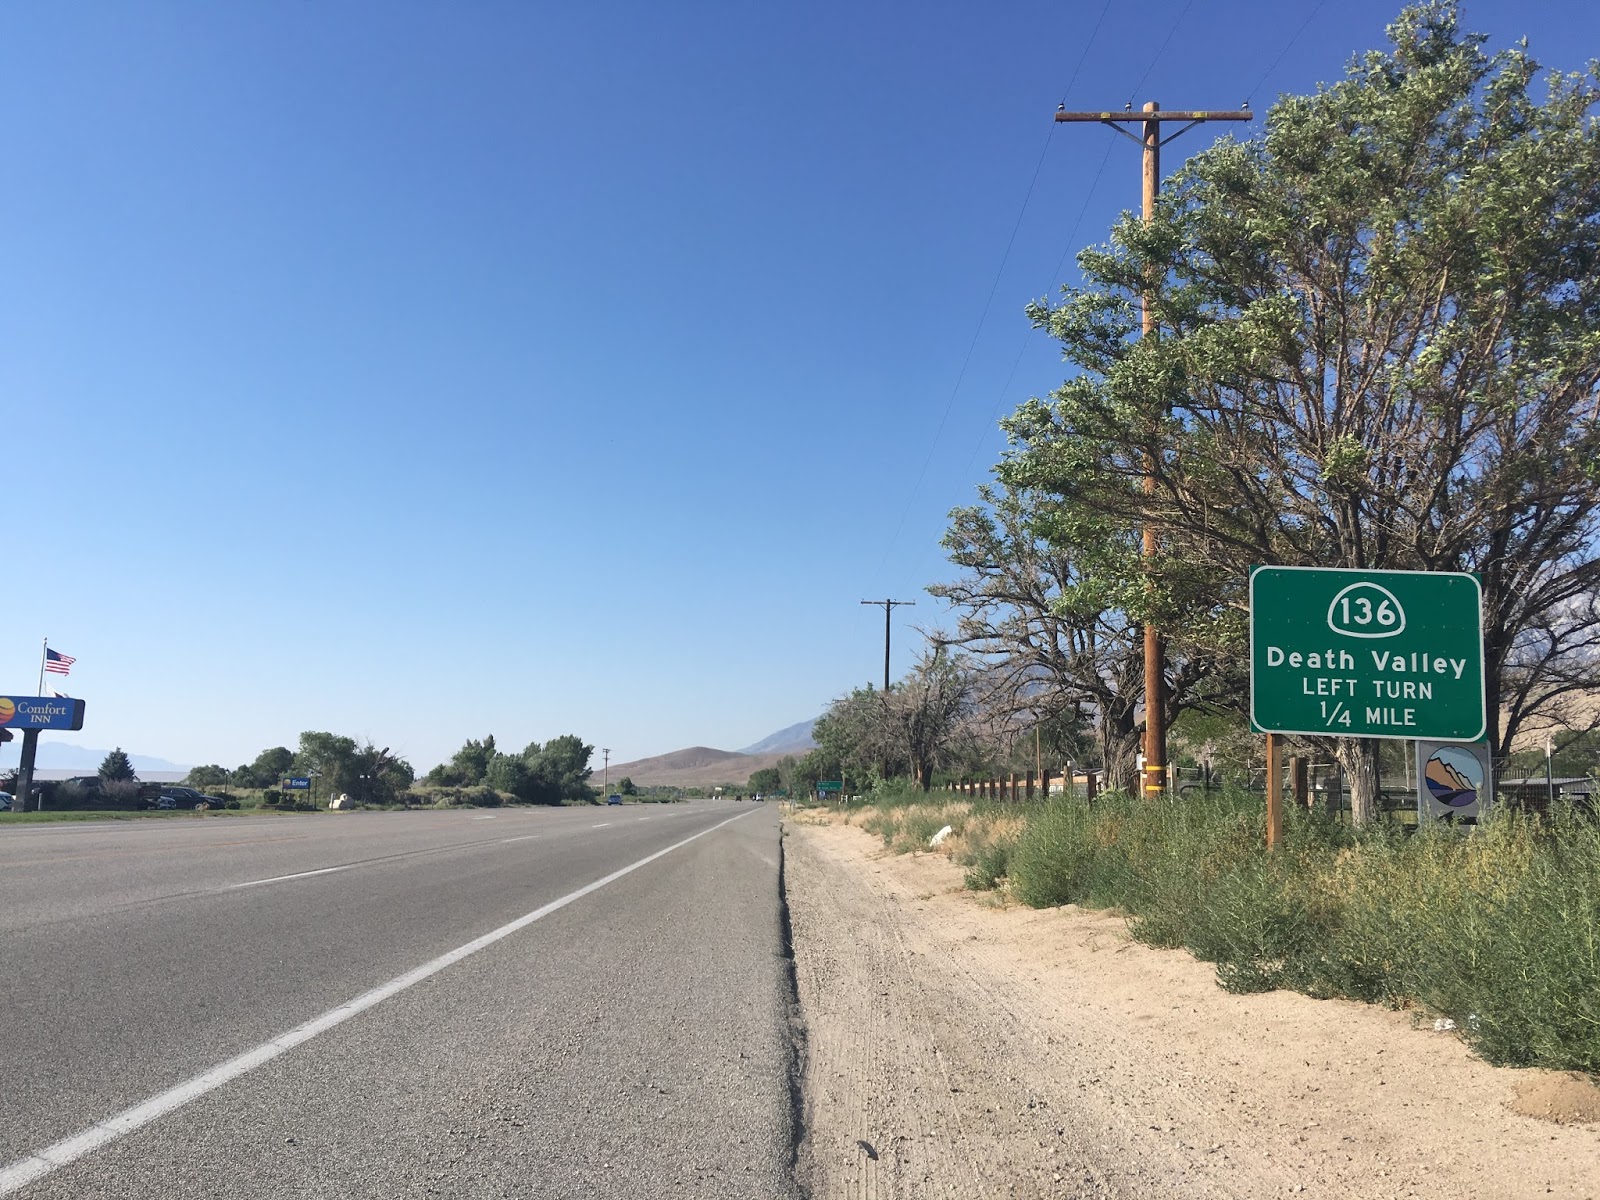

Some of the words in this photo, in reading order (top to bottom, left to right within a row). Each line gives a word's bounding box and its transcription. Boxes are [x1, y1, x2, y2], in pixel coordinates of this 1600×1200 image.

[1341, 598, 1396, 625] 136
[1267, 646, 1355, 670] Death
[1371, 651, 1467, 680] Valley
[1303, 677, 1358, 697] LEFT
[1373, 680, 1433, 700] TURN
[17, 701, 67, 715] Comfort
[30, 714, 52, 723] INN
[1320, 701, 1352, 727] 1/4
[1366, 706, 1416, 726] MILE
